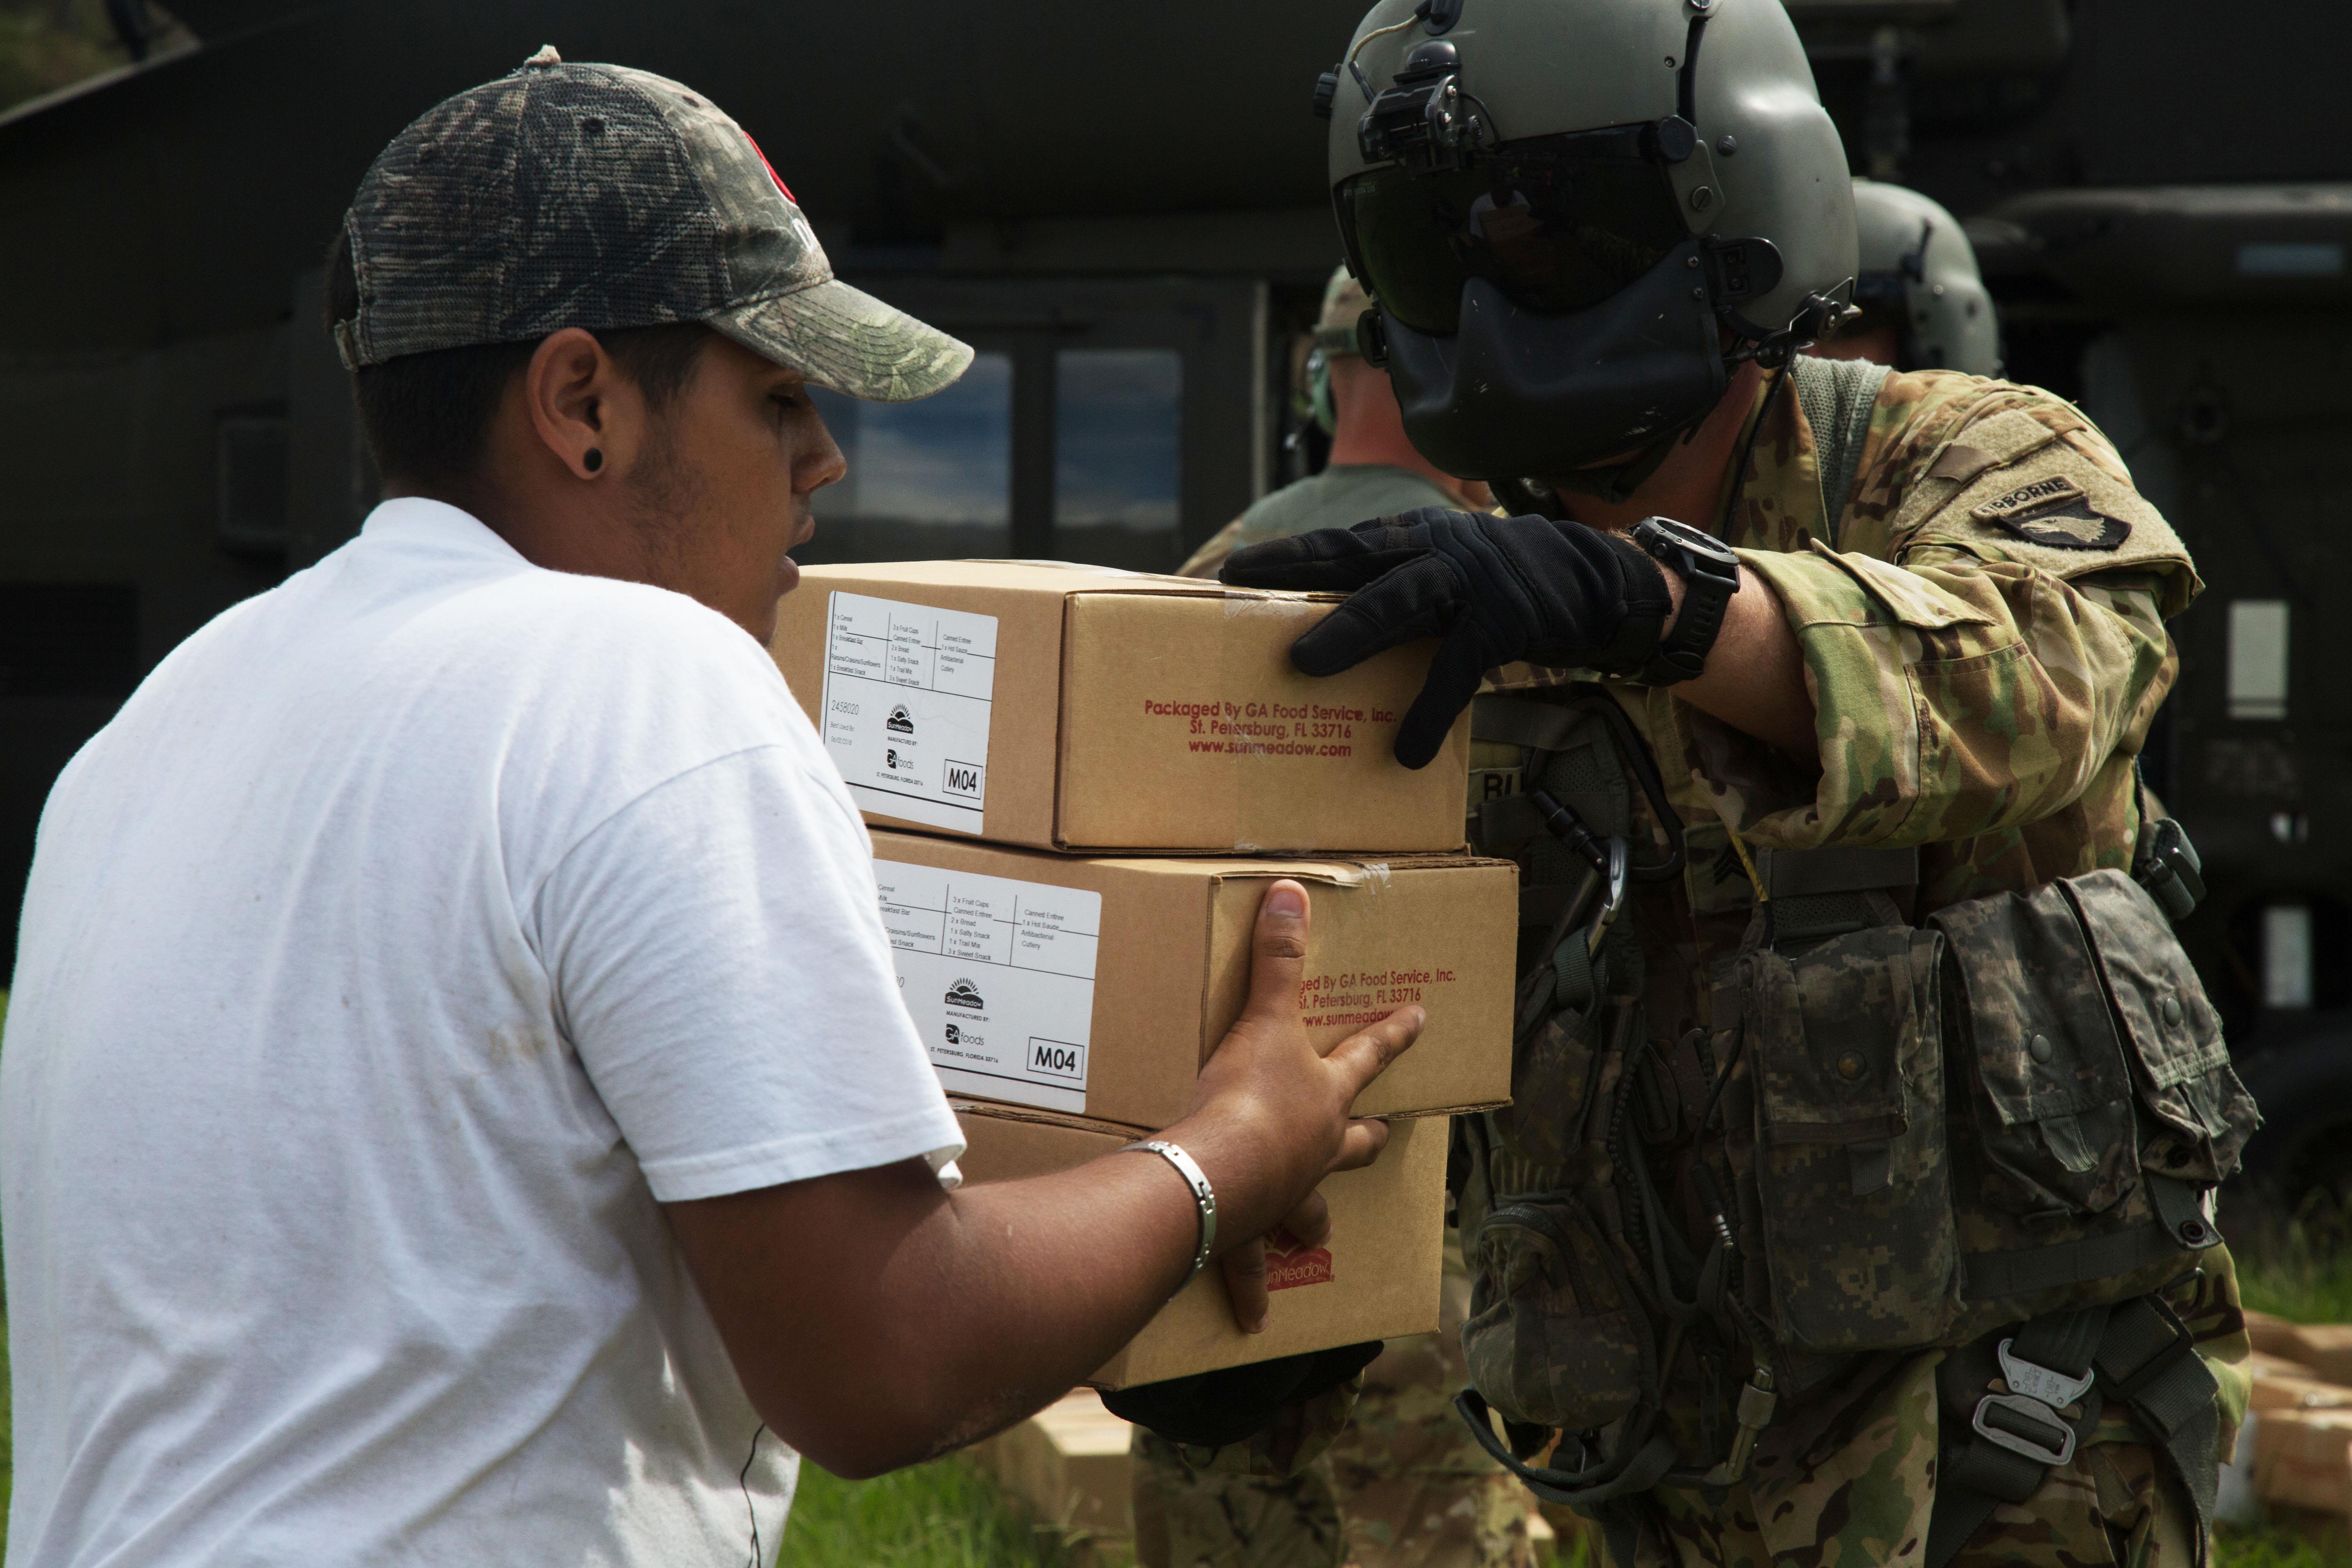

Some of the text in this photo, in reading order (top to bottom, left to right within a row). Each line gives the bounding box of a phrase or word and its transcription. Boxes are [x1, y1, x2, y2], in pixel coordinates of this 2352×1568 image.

[909, 627, 918, 635] Cups
[839, 635, 856, 643] Breakfast
[943, 634, 958, 642] Canned
[897, 655, 906, 664] Salty
[940, 654, 964, 664] Antibacterial
[836, 665, 854, 673] Breakfast
[940, 665, 954, 674] Cutlery
[831, 699, 860, 715] 2458020
[1145, 699, 1397, 723] Packaged By GA Food Service, Inc.
[1189, 719, 1352, 740] St. Petersburg, FL 33716
[1188, 739, 1352, 757] www.sunmeadow.com
[948, 766, 978, 792] M04
[878, 884, 895, 892] Cereal
[879, 905, 900, 914] reakfast
[975, 900, 989, 909] Cups
[953, 906, 993, 918] Canned Entree
[1024, 909, 1064, 921] Canned Entree
[960, 918, 976, 927] Bread
[1042, 922, 1060, 931] Sauce
[959, 929, 972, 938] Salty
[974, 931, 991, 940] Snack
[1021, 929, 1054, 940] Antibacterial
[898, 939, 914, 947] Snack
[1021, 940, 1040, 950] Cutlery
[957, 949, 973, 958] Sweet
[974, 952, 991, 961] Snack
[1323, 975, 1336, 992] By
[1340, 973, 1357, 989] GA
[1361, 971, 1388, 987] Food
[1390, 969, 1433, 985] Service,
[1436, 968, 1457, 982] Inc.
[946, 995, 982, 1008] SunMeadow
[1313, 993, 1373, 1009] Petersburg,
[1376, 989, 1387, 1004] FL
[1390, 987, 1422, 1003] 33716
[945, 1010, 982, 1021] MANUFACTURED
[937, 1048, 964, 1058] PETERSBURG,
[1035, 1045, 1076, 1072] M04
[1267, 1262, 1327, 1285] unMeadow
